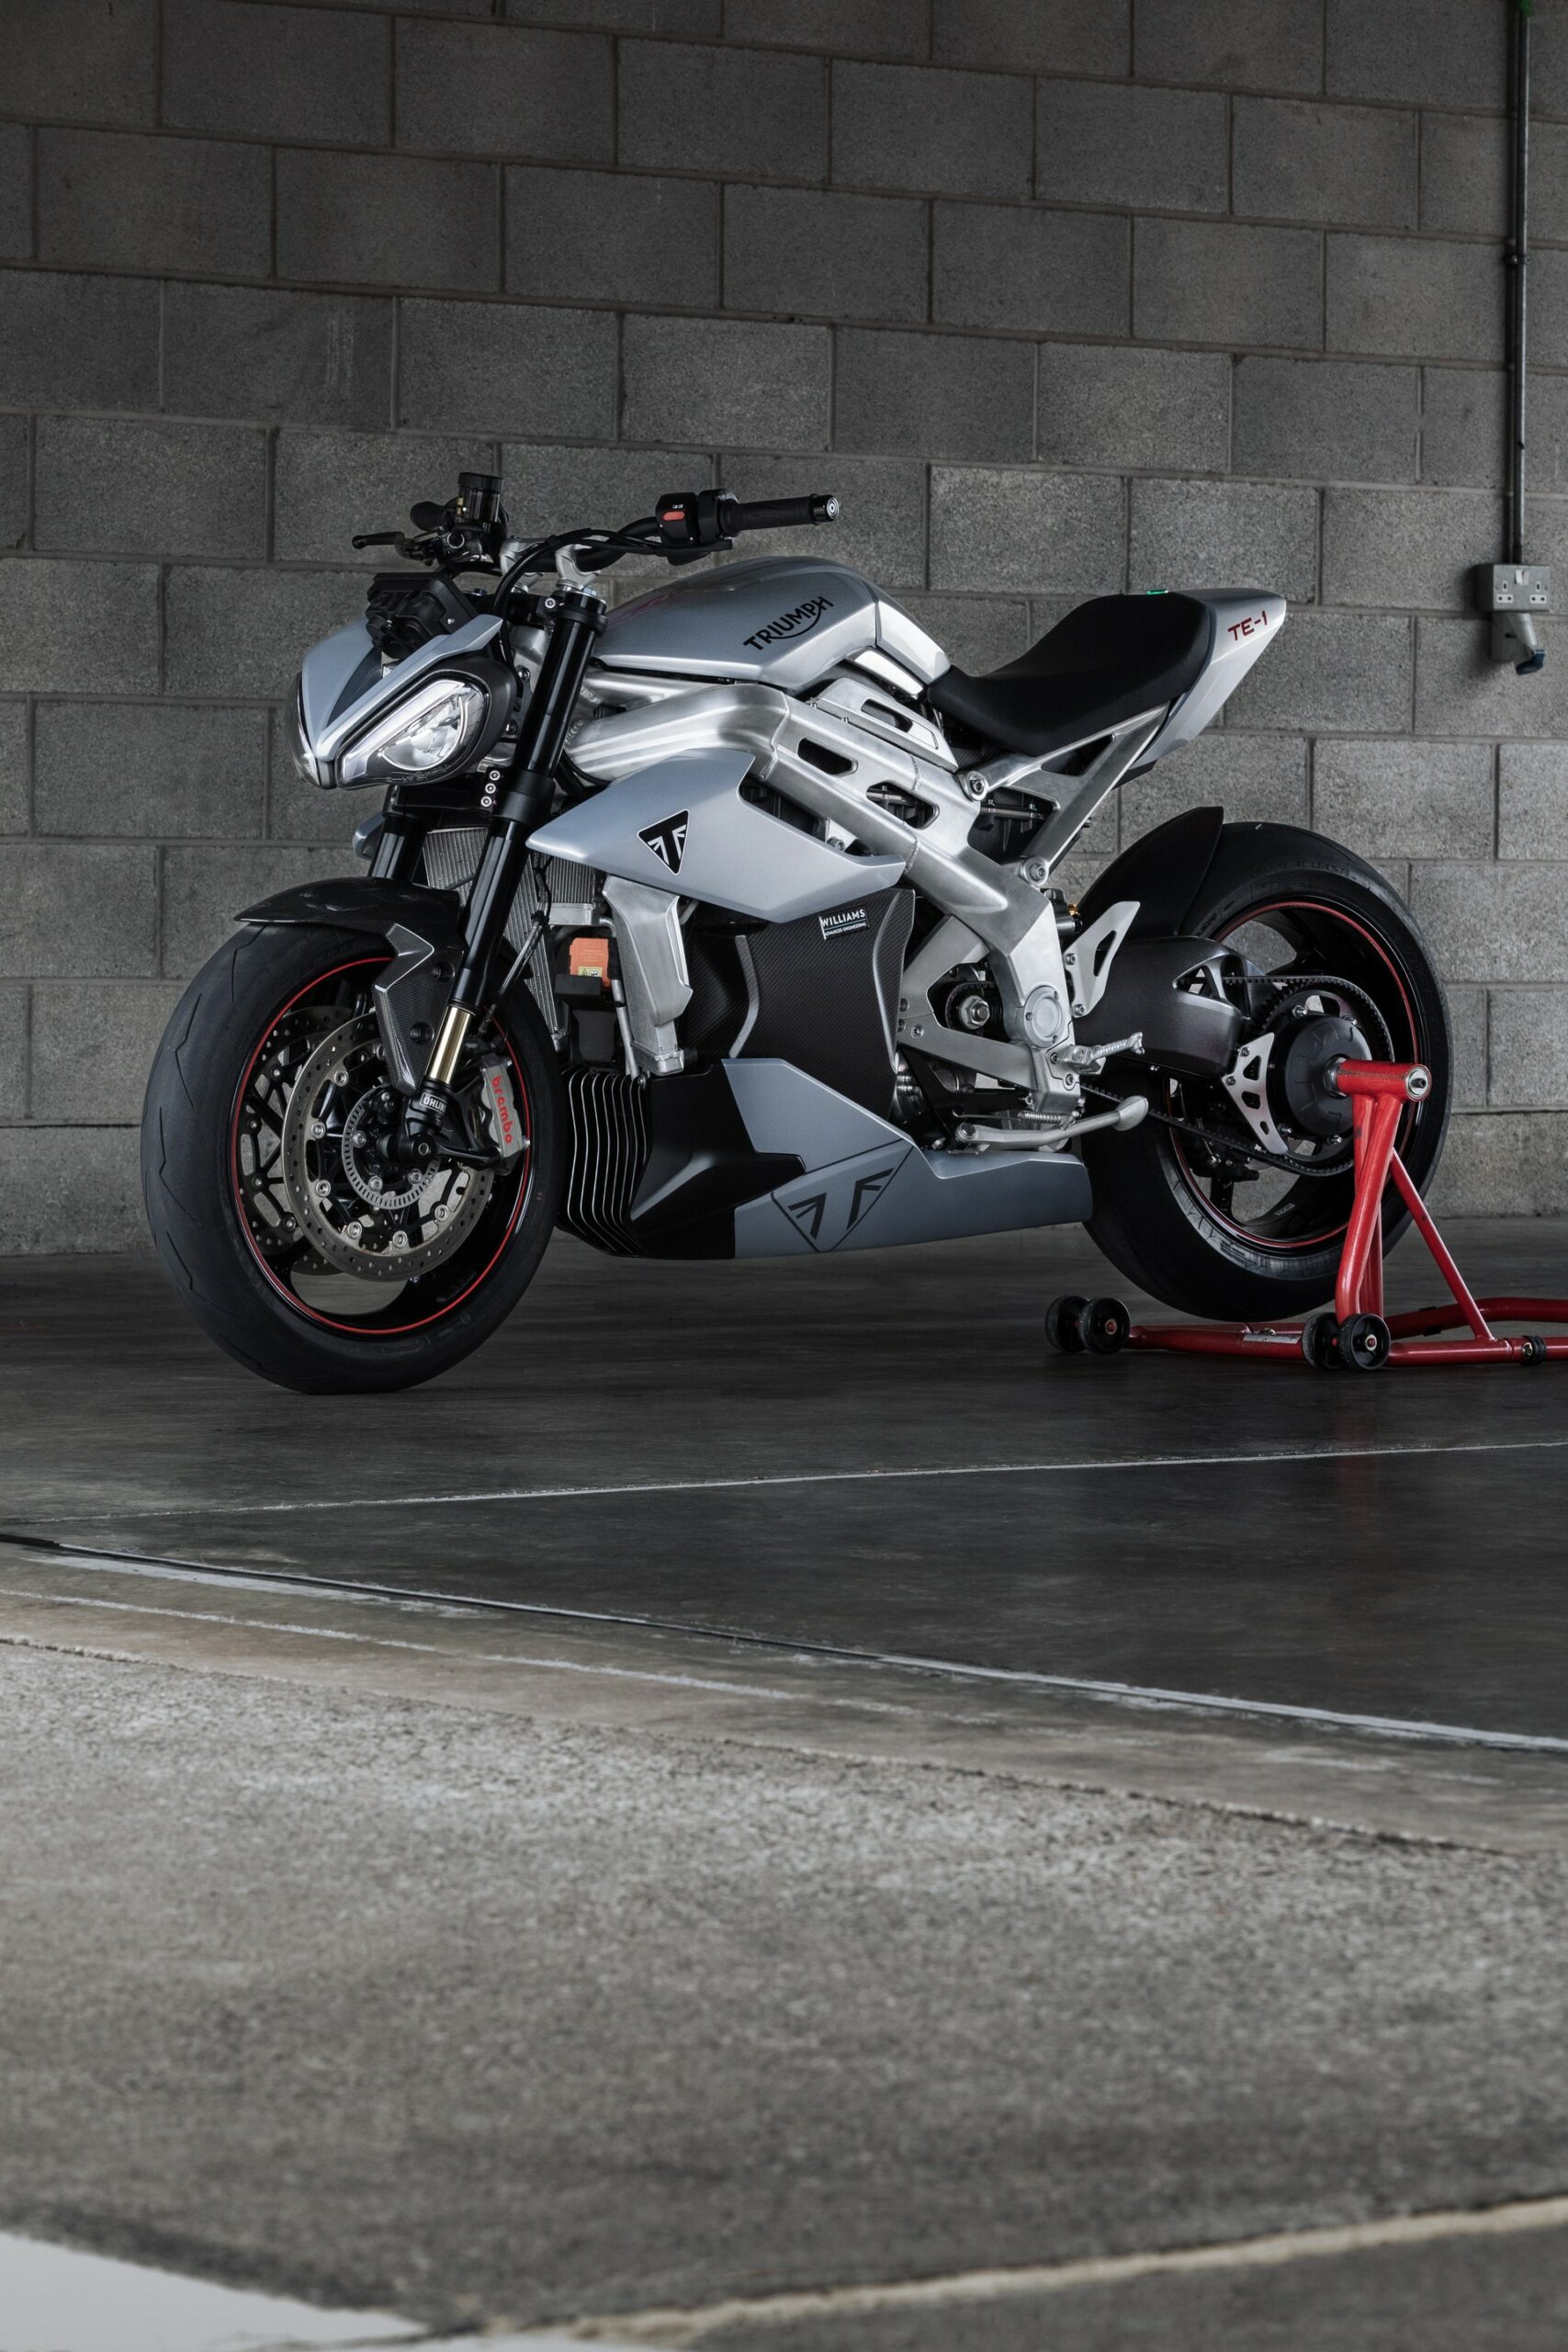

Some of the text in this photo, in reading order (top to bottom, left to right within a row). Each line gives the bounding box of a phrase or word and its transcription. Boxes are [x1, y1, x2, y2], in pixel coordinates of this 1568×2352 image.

[742, 595, 834, 650] TRIUMPH
[1227, 610, 1268, 641] TE-1
[819, 909, 865, 927] WILLIAMS
[491, 1076, 513, 1145] brembo
